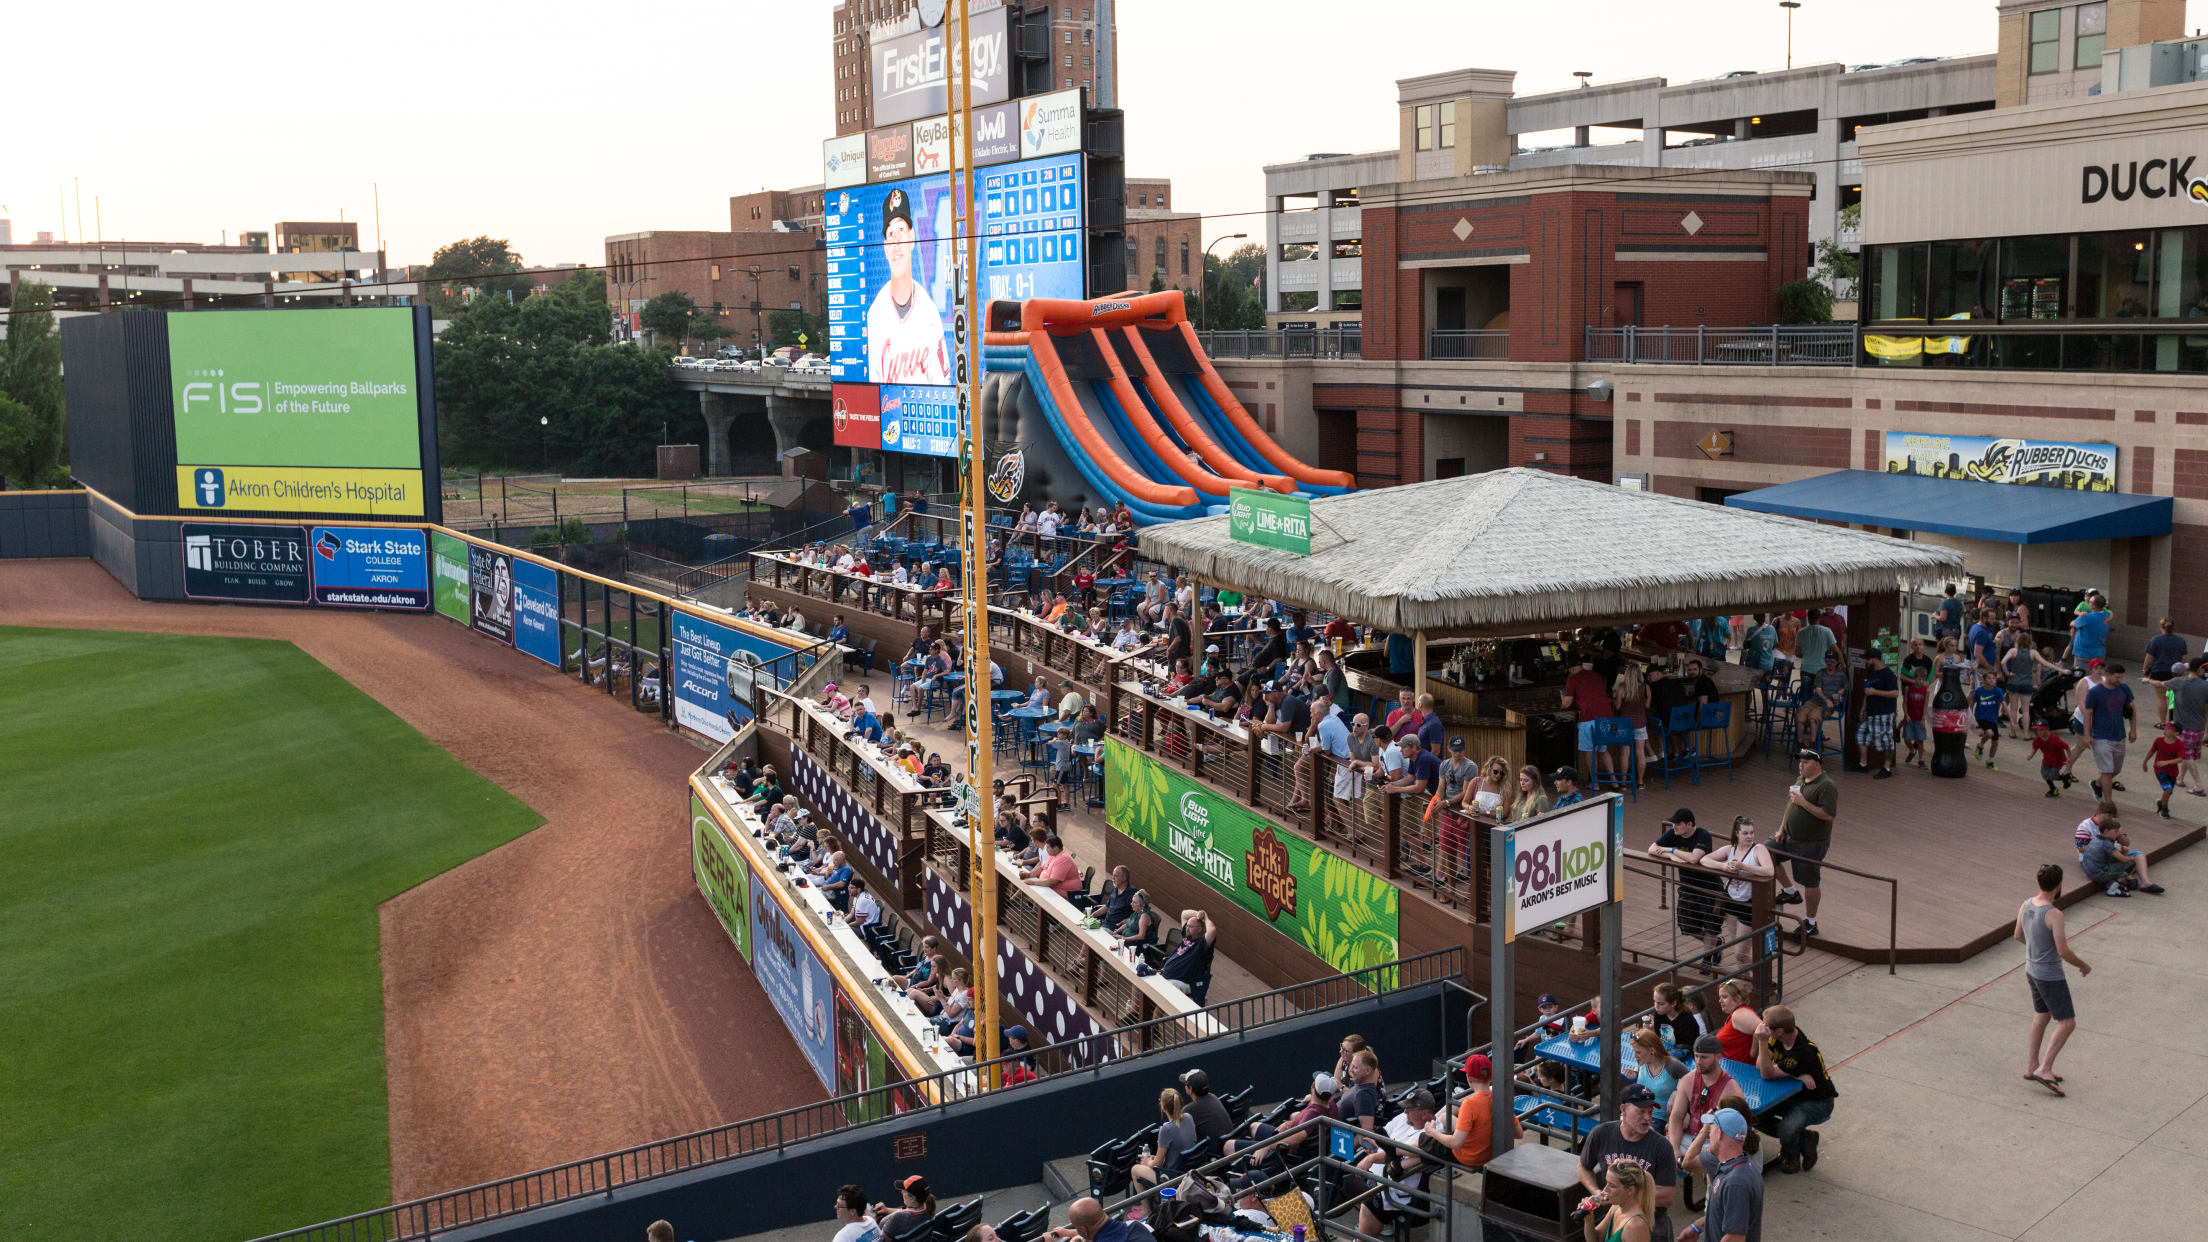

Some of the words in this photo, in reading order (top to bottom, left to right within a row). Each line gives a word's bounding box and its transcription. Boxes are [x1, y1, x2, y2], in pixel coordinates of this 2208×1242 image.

[1038, 105, 1075, 124] Summa
[916, 120, 961, 145] KeyBak
[1048, 123, 1075, 142] Health
[841, 150, 865, 163] Unique
[2082, 156, 2197, 204] DUCK
[953, 263, 969, 435] Leaf
[274, 382, 347, 397] Empowering
[350, 382, 407, 398] Ballparks
[275, 401, 288, 413] of
[290, 401, 309, 413] the
[312, 401, 350, 413] Future
[229, 479, 269, 497] Akron
[274, 480, 342, 500] Children's
[346, 481, 406, 504] Hospital
[1237, 503, 1251, 513] BUD
[213, 538, 304, 561] TOBER
[346, 540, 382, 554] Stark
[385, 541, 421, 556] State
[214, 561, 257, 571] BUILDING
[261, 562, 304, 573] COMPANY
[365, 556, 402, 566] COLLEGE
[371, 575, 399, 584] AKRON
[327, 593, 416, 606] starkstate.edu/akron
[523, 595, 545, 616] Cleveland
[680, 626, 689, 640] The
[690, 630, 702, 645] Best
[703, 634, 721, 653] Lineup
[681, 643, 691, 657] Just
[682, 680, 718, 701] Accord
[1183, 807, 1209, 829] LIGHT
[1187, 799, 1208, 818] BUD
[1259, 841, 1282, 874] Tiki
[702, 828, 746, 927] SERRA
[1247, 853, 1296, 910] Terrace
[1521, 888, 1554, 910] AKRON'S
[1556, 882, 1572, 899] BEST
[1574, 872, 1598, 891] MUSIC
